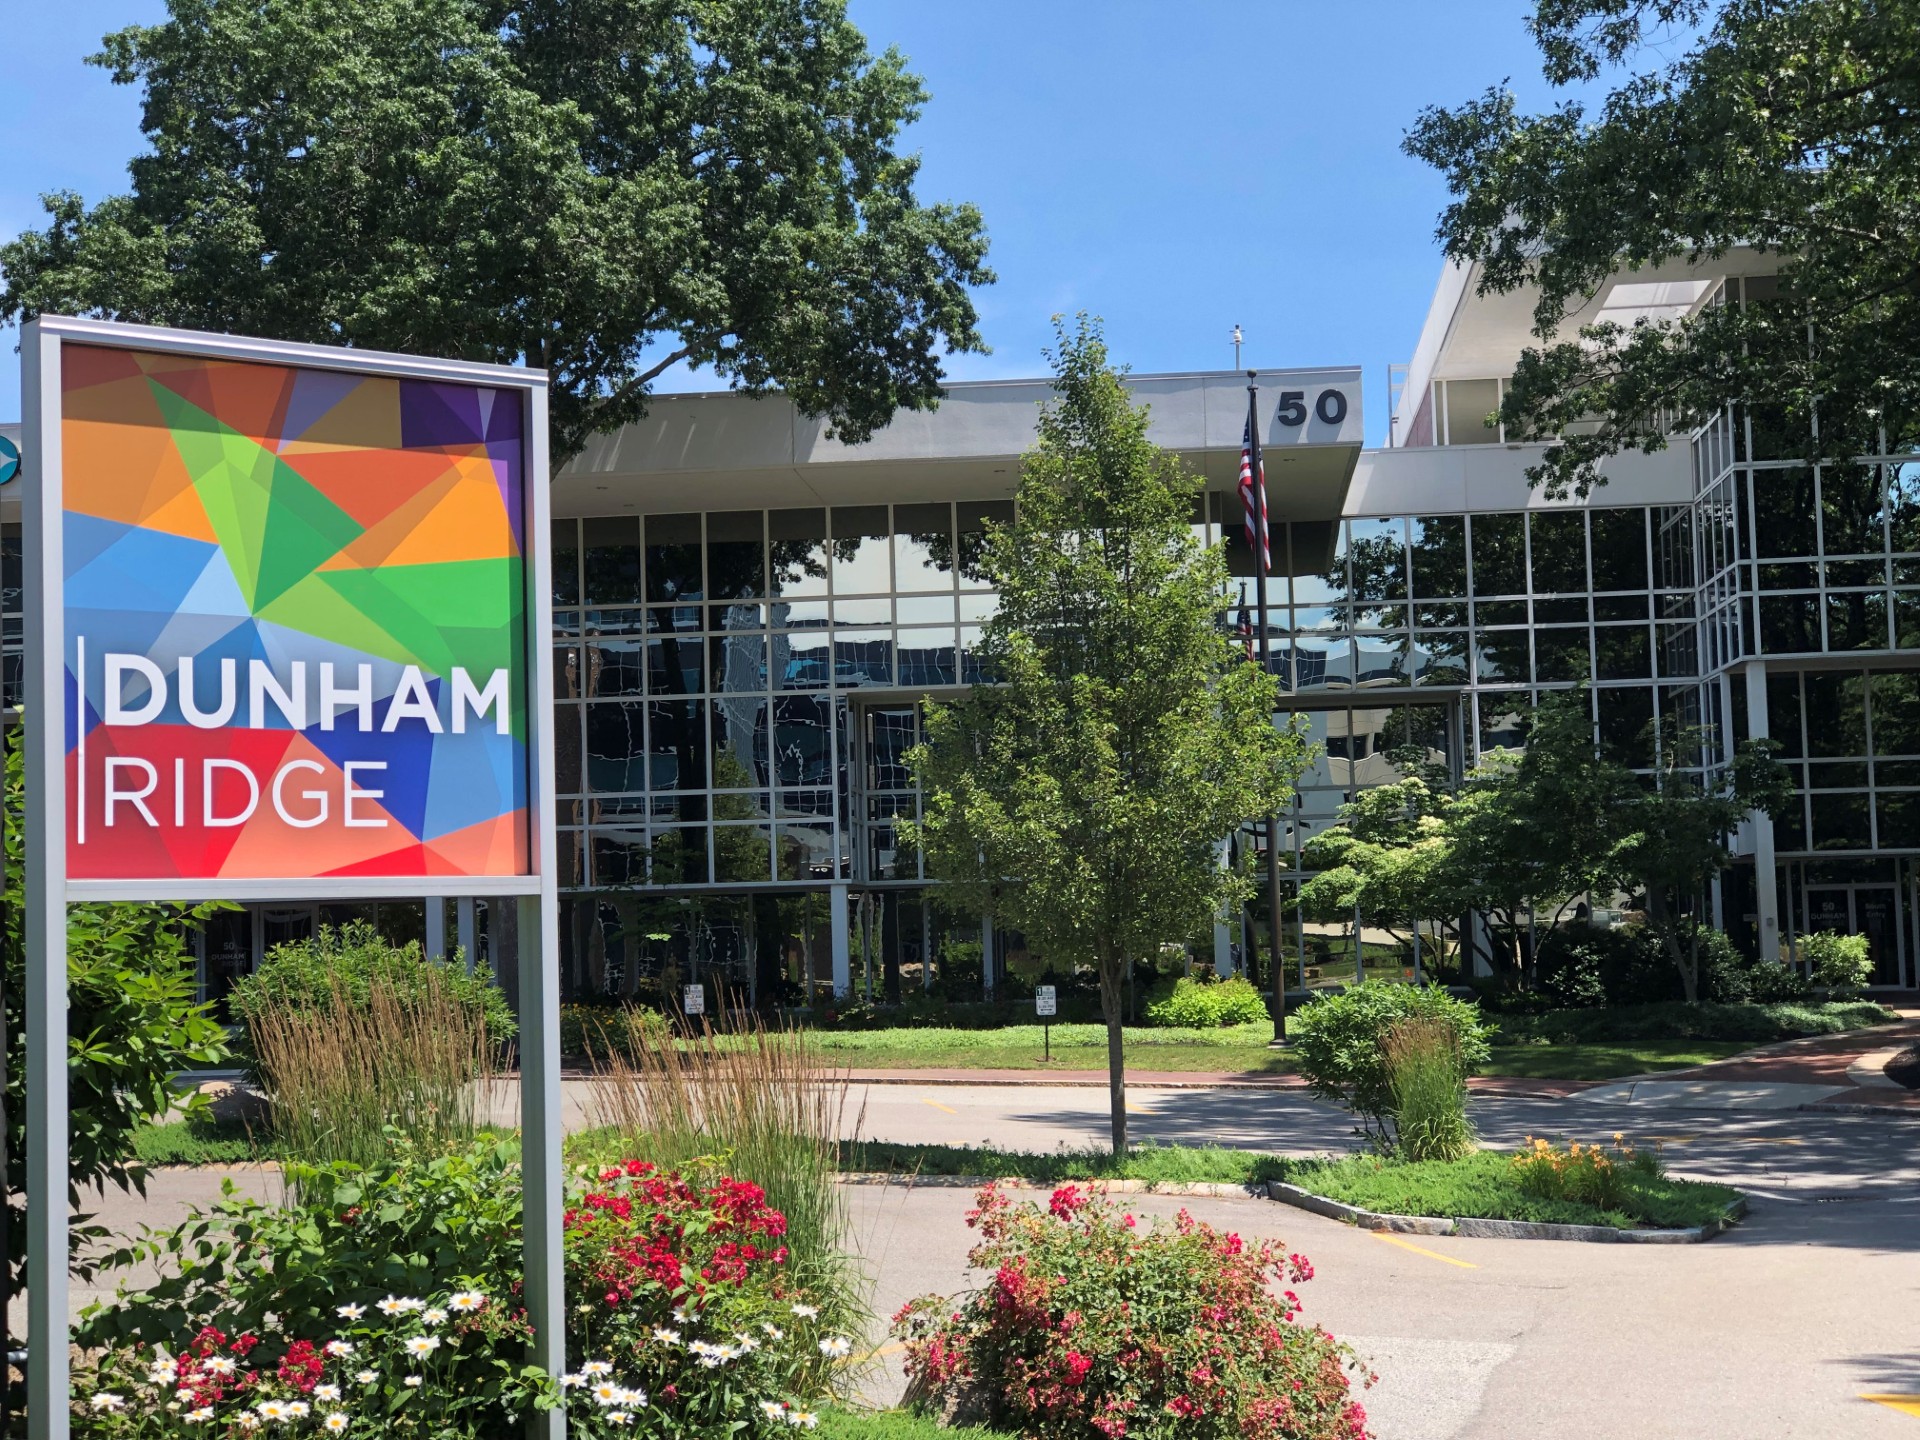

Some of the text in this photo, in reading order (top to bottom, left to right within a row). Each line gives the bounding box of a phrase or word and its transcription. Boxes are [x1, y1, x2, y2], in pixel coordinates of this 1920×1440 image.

[1278, 388, 1348, 426] 50
[104, 653, 510, 735] DUNHAM
[104, 756, 389, 829] RIDGE
[223, 942, 235, 950] 50
